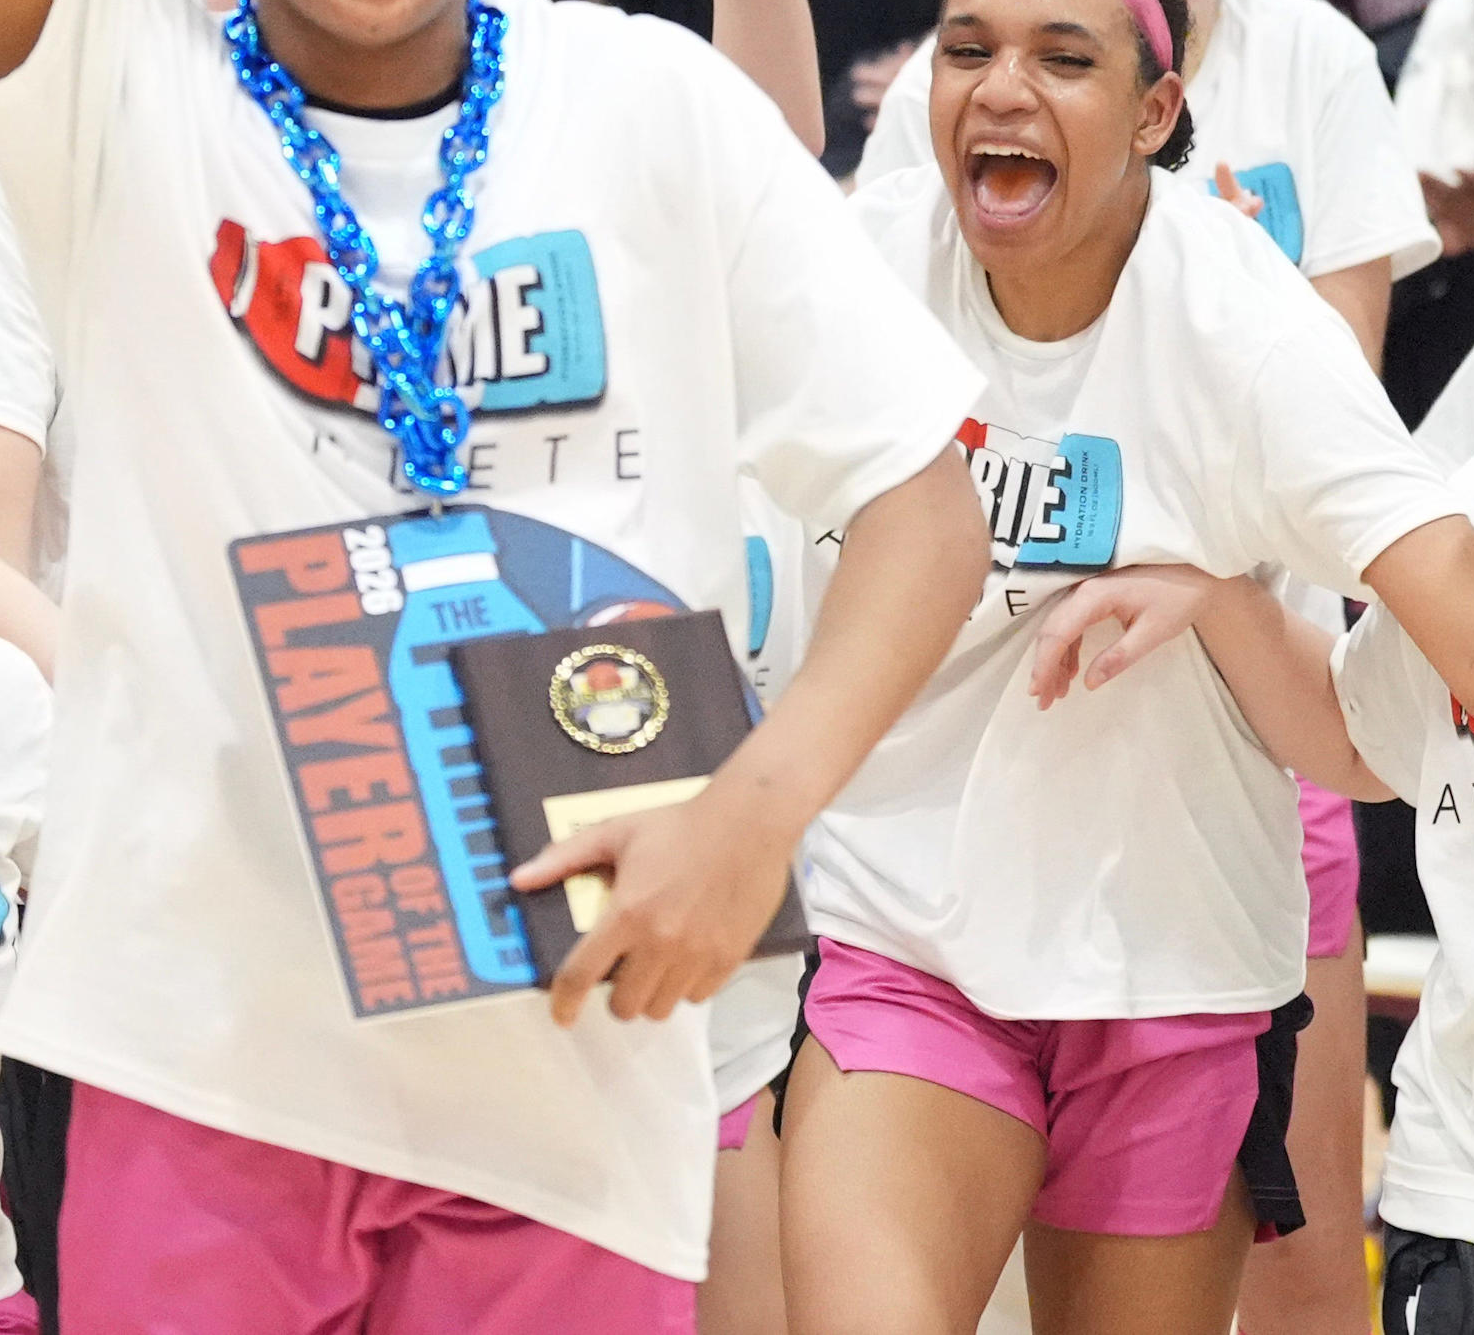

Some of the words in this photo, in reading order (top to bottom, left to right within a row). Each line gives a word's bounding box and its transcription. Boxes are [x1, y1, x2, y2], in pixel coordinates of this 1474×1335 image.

[295, 262, 550, 386] PME
[1080, 450, 1089, 483] DRINK
[1073, 486, 1088, 549] HYDRATION
[431, 595, 491, 632] THE
[238, 530, 427, 876] PLAYER
[389, 864, 444, 914] OF
[331, 873, 416, 1009] GAME
[406, 919, 468, 999] THE
